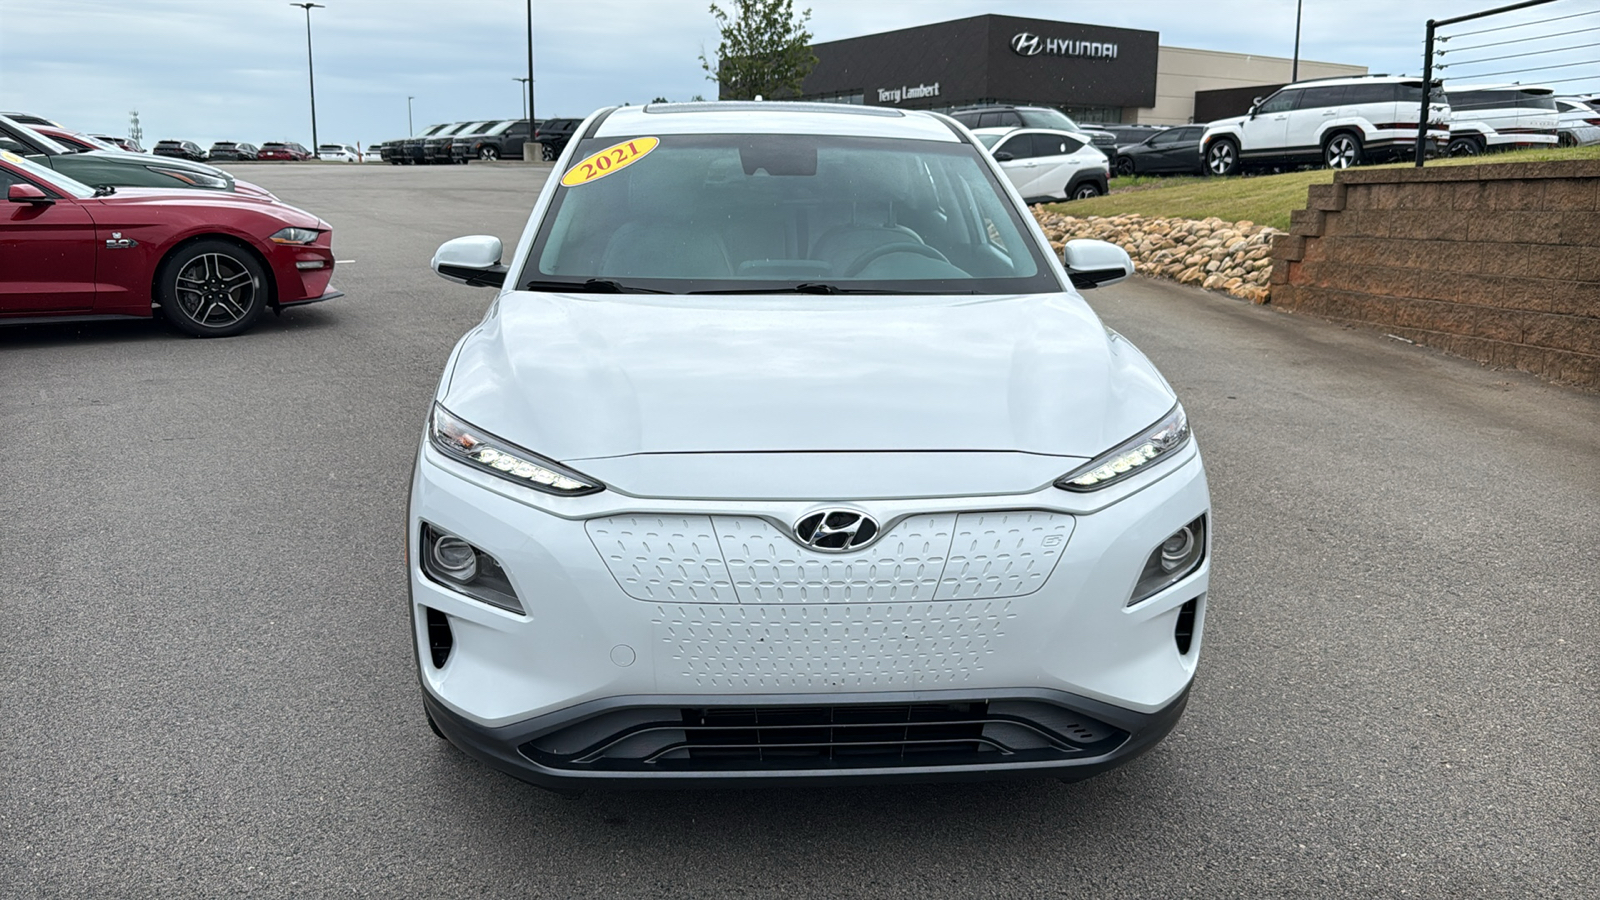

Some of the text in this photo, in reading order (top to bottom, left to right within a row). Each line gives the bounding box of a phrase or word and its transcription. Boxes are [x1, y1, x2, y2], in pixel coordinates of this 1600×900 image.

[1046, 38, 1118, 58] HYUNDAI
[877, 82, 939, 104] Terry Lambert
[580, 142, 641, 180] 2021
